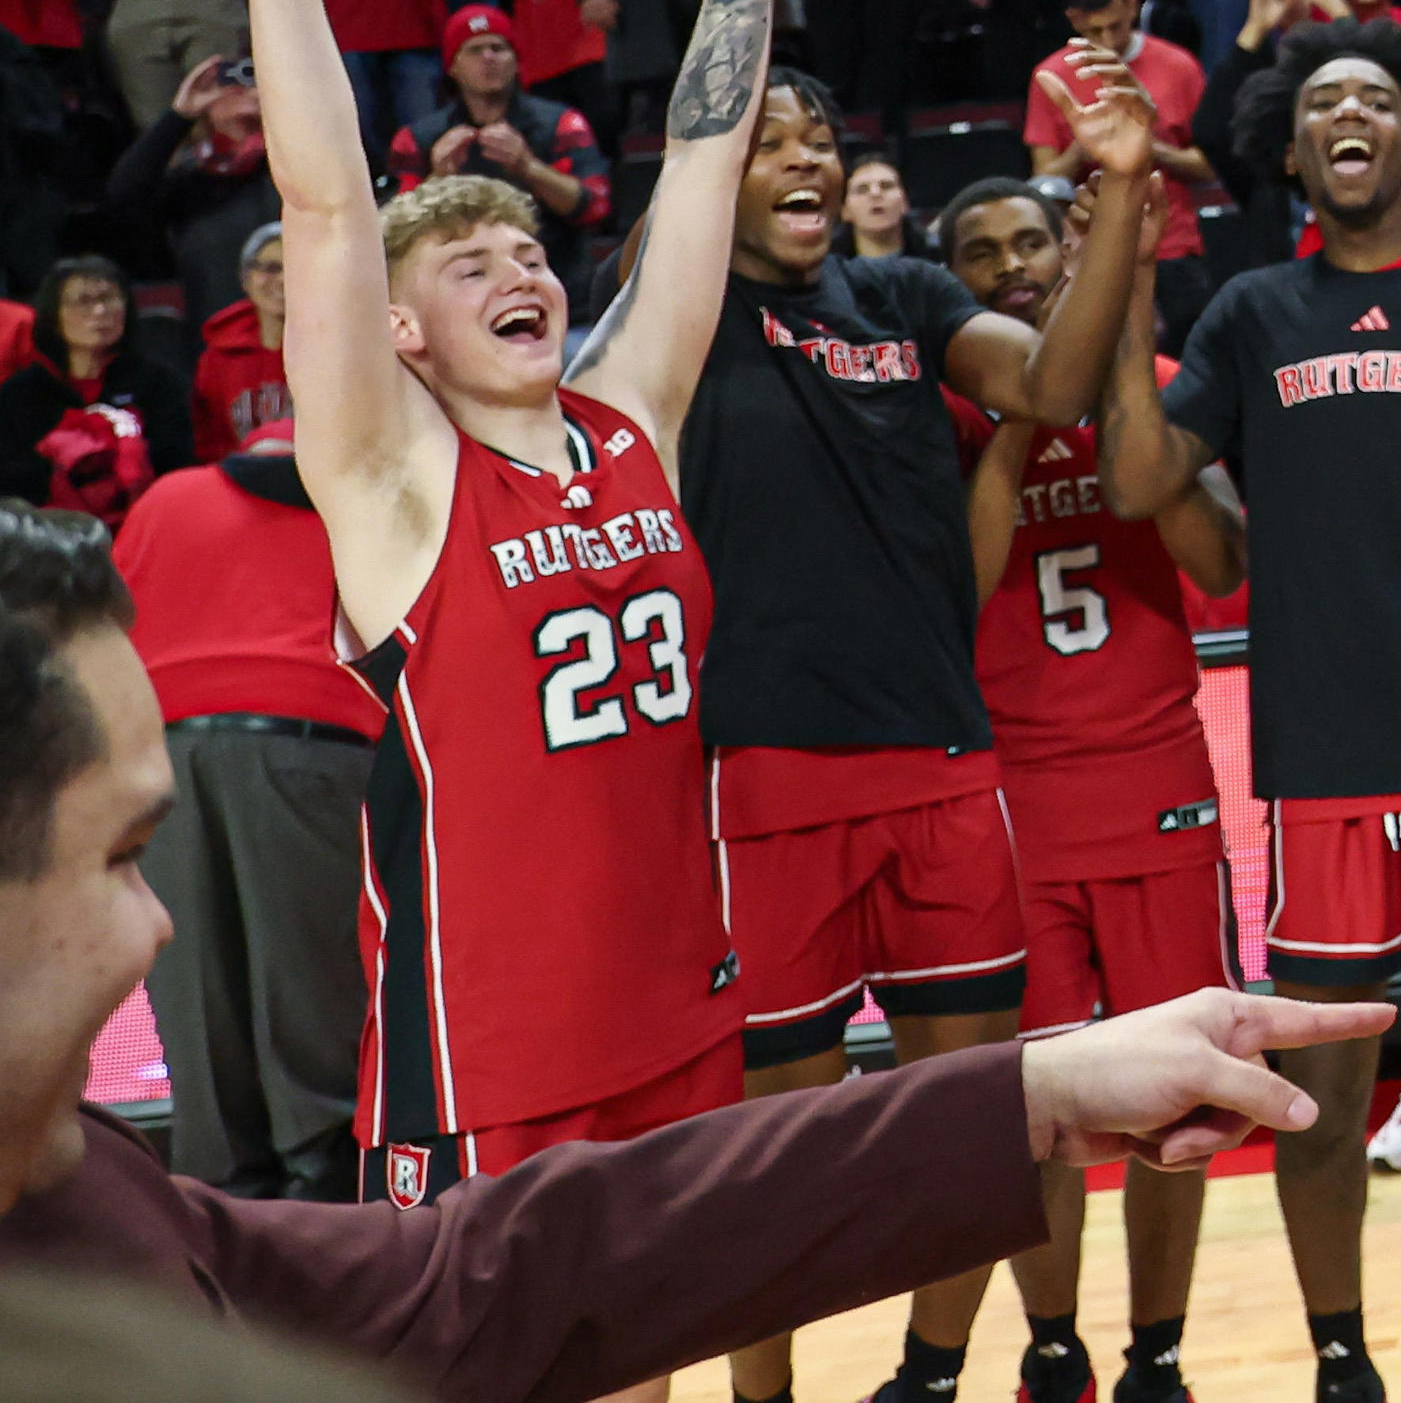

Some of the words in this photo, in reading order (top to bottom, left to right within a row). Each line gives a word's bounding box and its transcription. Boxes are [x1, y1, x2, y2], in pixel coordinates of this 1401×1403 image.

[490, 507, 684, 590] RUTGERS
[1034, 543, 1112, 657] 5
[533, 588, 695, 754] 23
[393, 1156, 419, 1201] R
